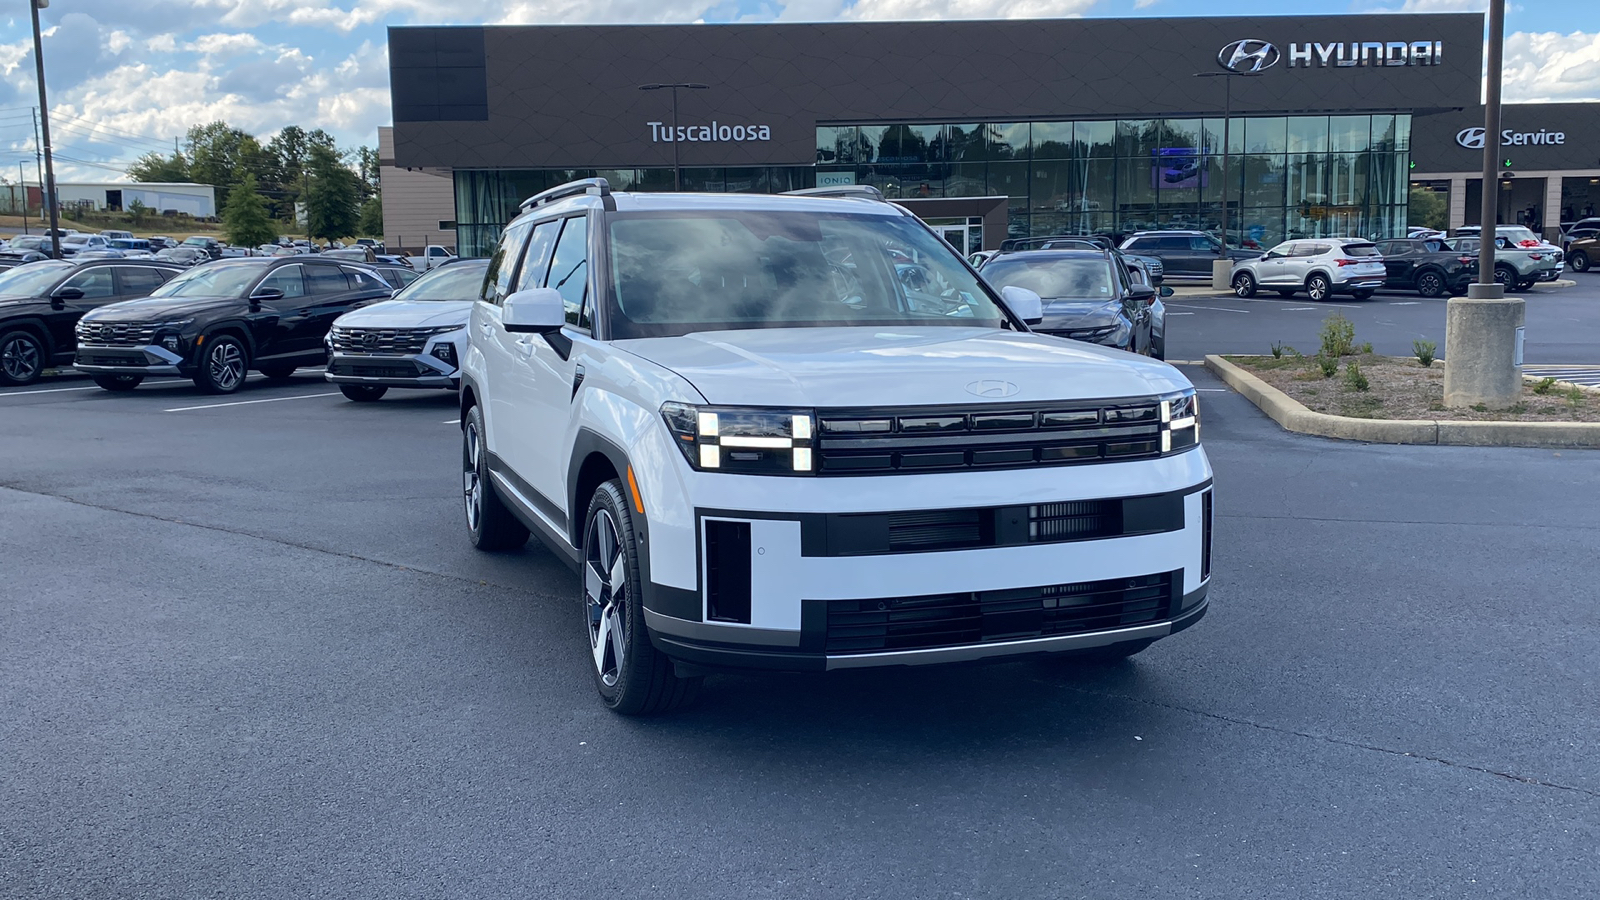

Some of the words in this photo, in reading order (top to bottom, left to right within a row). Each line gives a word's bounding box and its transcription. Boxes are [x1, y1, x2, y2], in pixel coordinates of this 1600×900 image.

[1289, 40, 1442, 67] HYUNDAI
[646, 121, 771, 142] Tuscaloosa
[1500, 128, 1566, 146] Service
